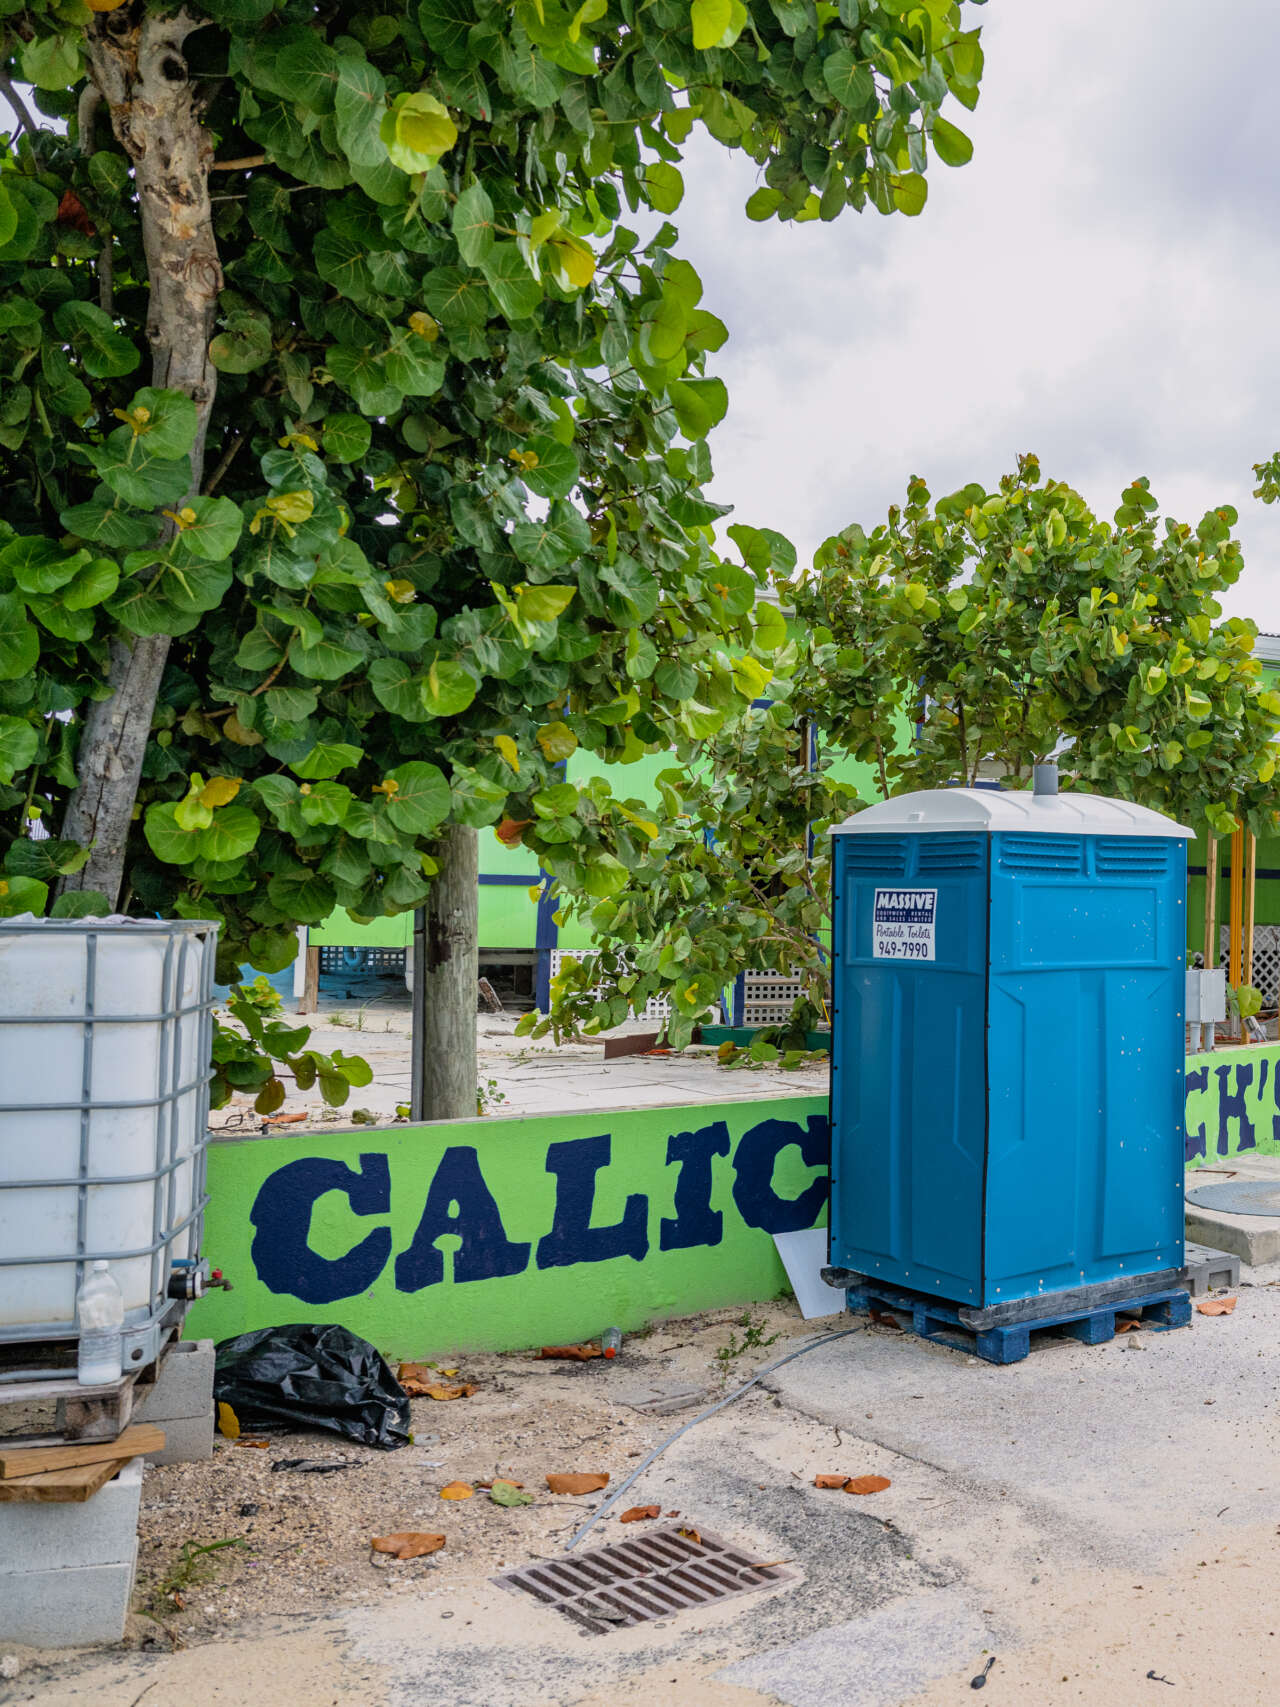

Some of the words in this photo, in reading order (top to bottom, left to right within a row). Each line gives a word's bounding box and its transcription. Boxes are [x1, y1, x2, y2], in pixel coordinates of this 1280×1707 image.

[877, 893, 934, 910] MASSIVE
[876, 924, 905, 938] Portable
[907, 925, 931, 939] Toilets
[878, 941, 928, 958] 949-7990
[249, 1114, 830, 1304] CALIC
